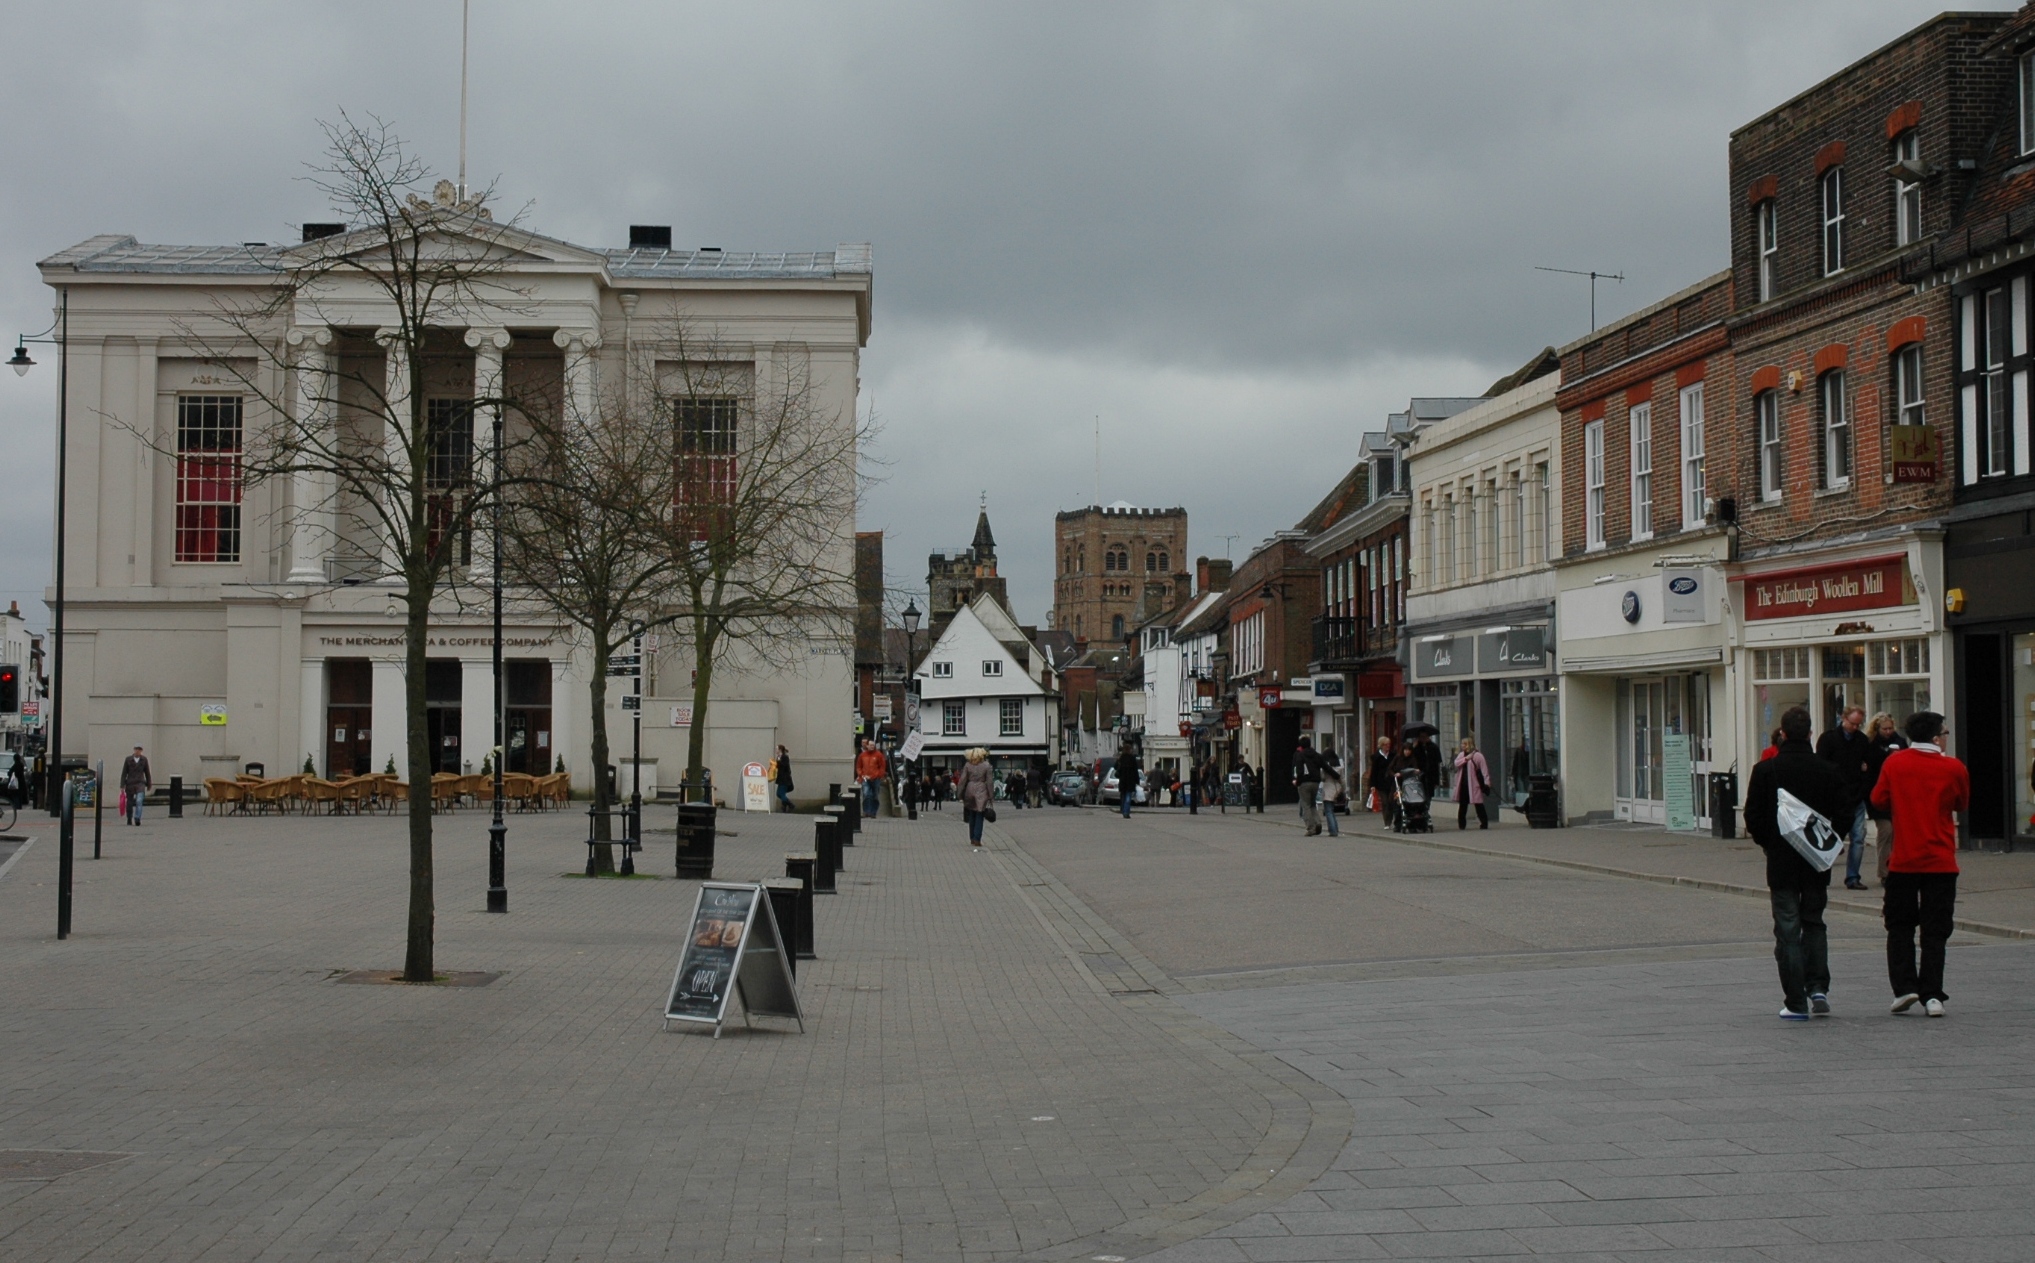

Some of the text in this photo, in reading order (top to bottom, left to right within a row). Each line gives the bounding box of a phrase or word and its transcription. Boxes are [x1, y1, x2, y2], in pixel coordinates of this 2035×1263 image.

[1898, 466, 1931, 478] EWM
[1756, 571, 1883, 608] The Edinburgh Woollen Mill
[320, 637, 343, 646] THE
[438, 637, 447, 646] &
[449, 637, 495, 646] COFFEE
[1512, 653, 1540, 662] Clarks
[748, 782, 765, 795] SALE
[692, 970, 718, 993] OPEN
